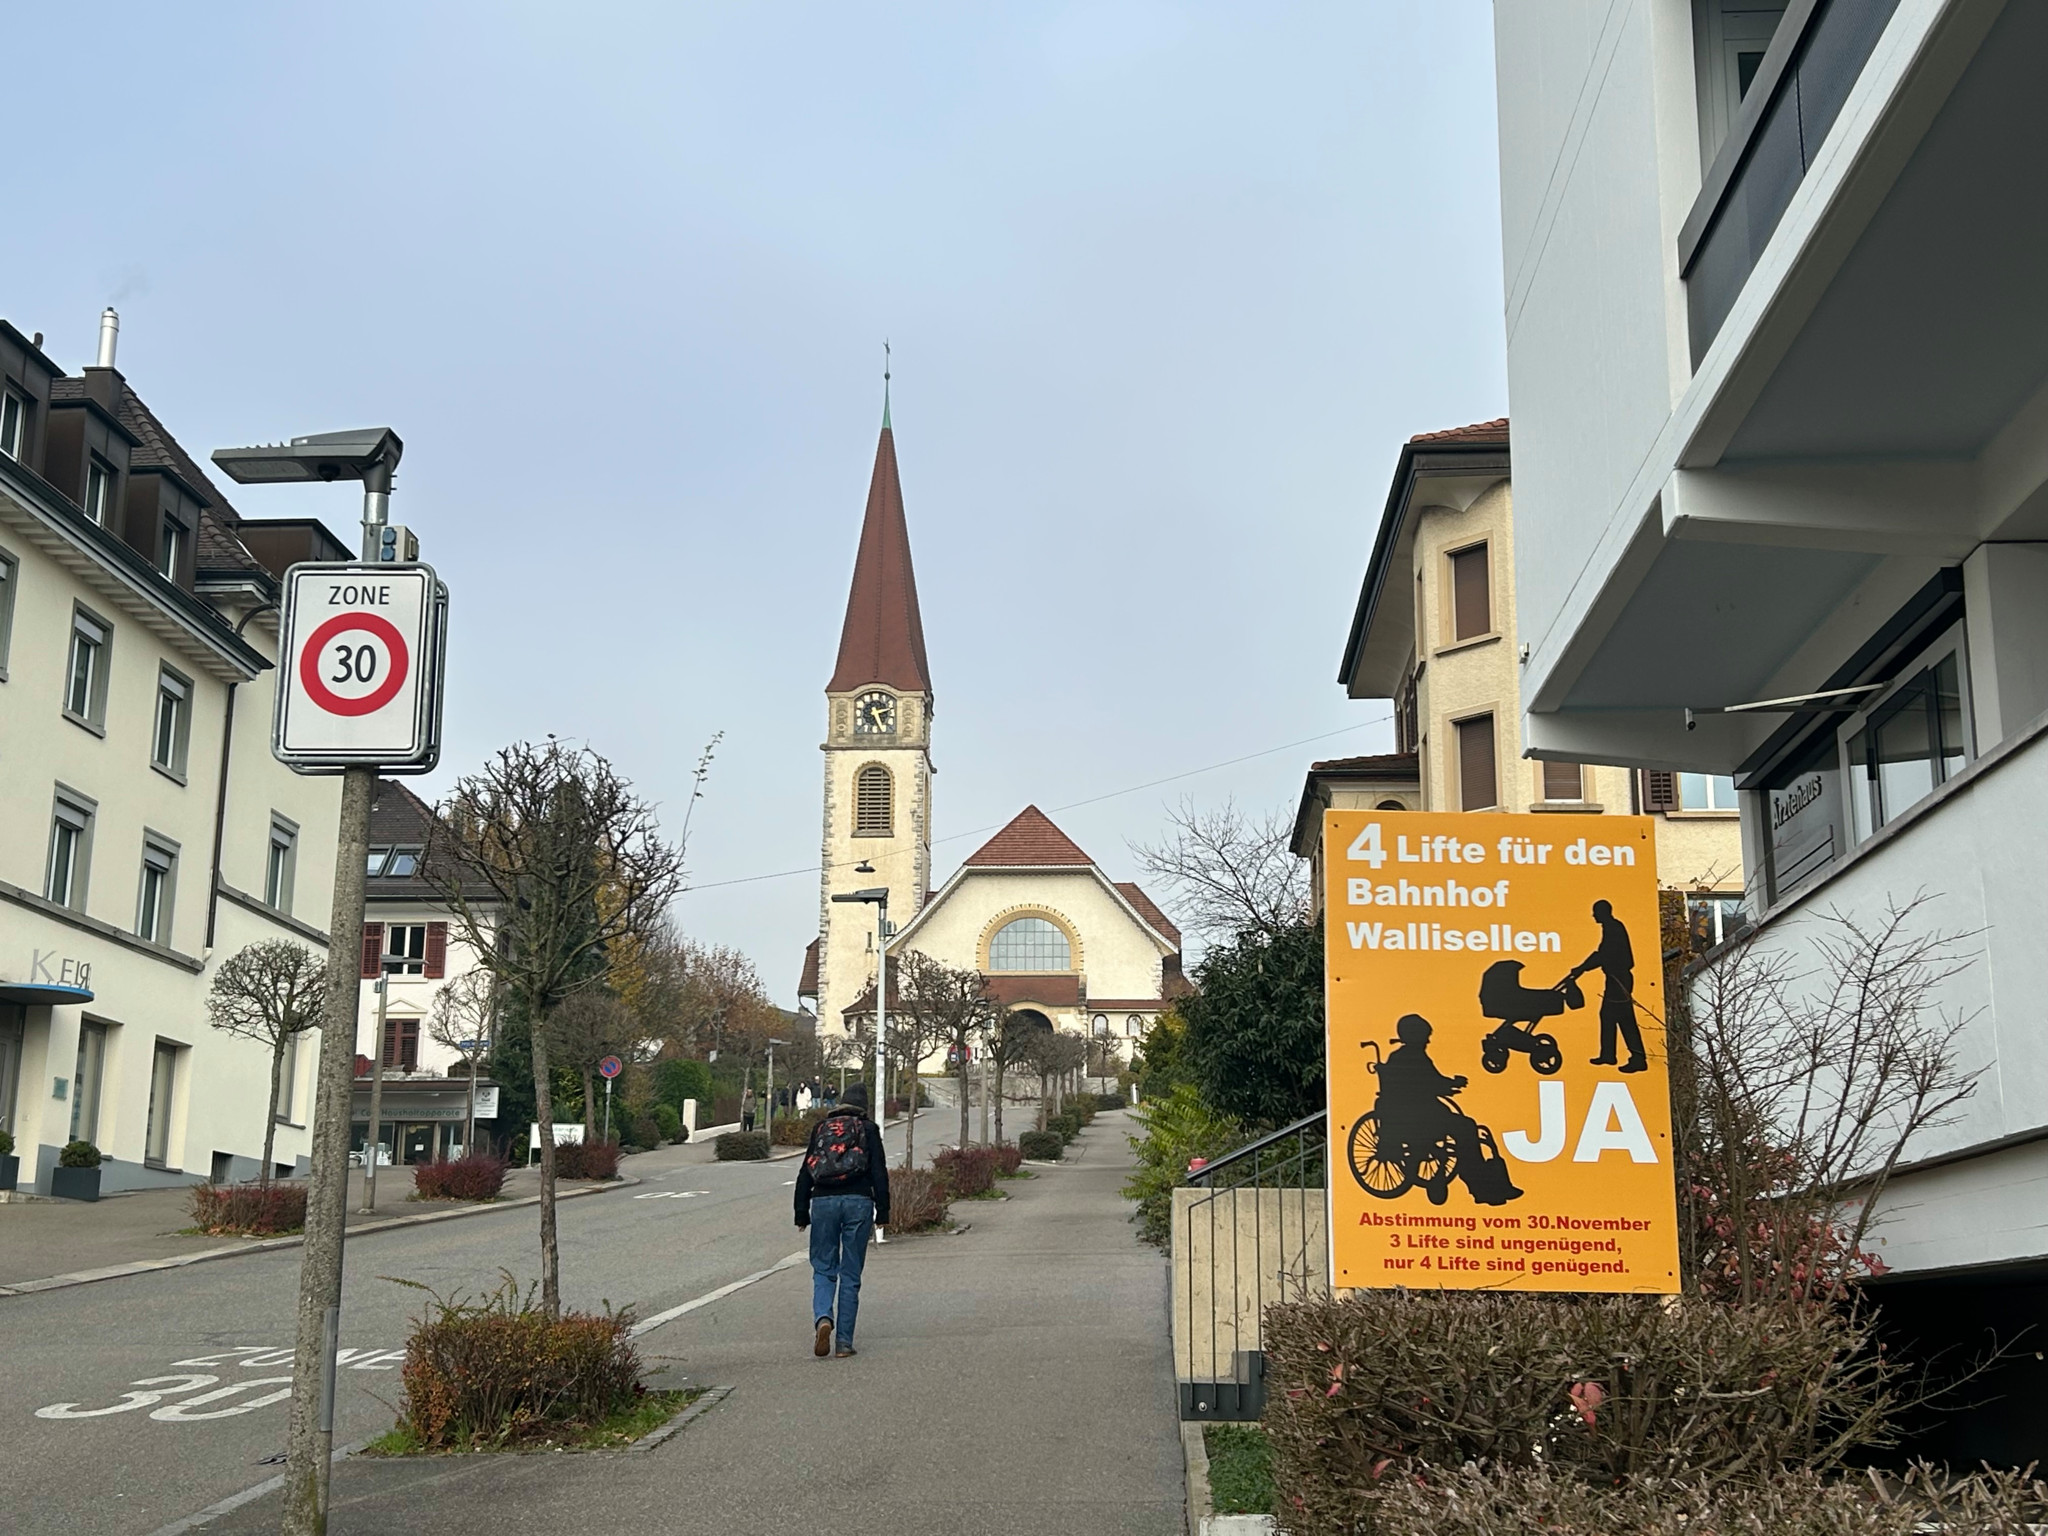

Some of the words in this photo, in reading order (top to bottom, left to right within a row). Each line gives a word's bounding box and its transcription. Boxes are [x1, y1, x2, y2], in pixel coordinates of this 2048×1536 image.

[328, 585, 391, 605] ZONE
[331, 644, 377, 683] 30
[1347, 823, 1387, 869] 4
[1397, 835, 1486, 864] Lifte
[1497, 836, 1553, 865] für
[1564, 838, 1635, 866] den
[1347, 877, 1510, 907] Bahnhof
[1346, 921, 1561, 953] Wallisellen
[1501, 1080, 1660, 1164] JA
[1359, 1212, 1477, 1232] Abstimmung
[1482, 1217, 1521, 1229] vom
[1527, 1215, 1652, 1231] 30.November
[1390, 1233, 1401, 1248] 3
[1407, 1234, 1450, 1249] Lifte
[1455, 1235, 1495, 1250] sind
[1501, 1237, 1622, 1255] ungenügend,
[1383, 1258, 1415, 1269] nur
[1419, 1255, 1432, 1270] 4
[1437, 1255, 1481, 1271] Lifte
[1486, 1256, 1525, 1272] sind
[1531, 1258, 1630, 1276] genügend.
[35, 1373, 294, 1422] 30
